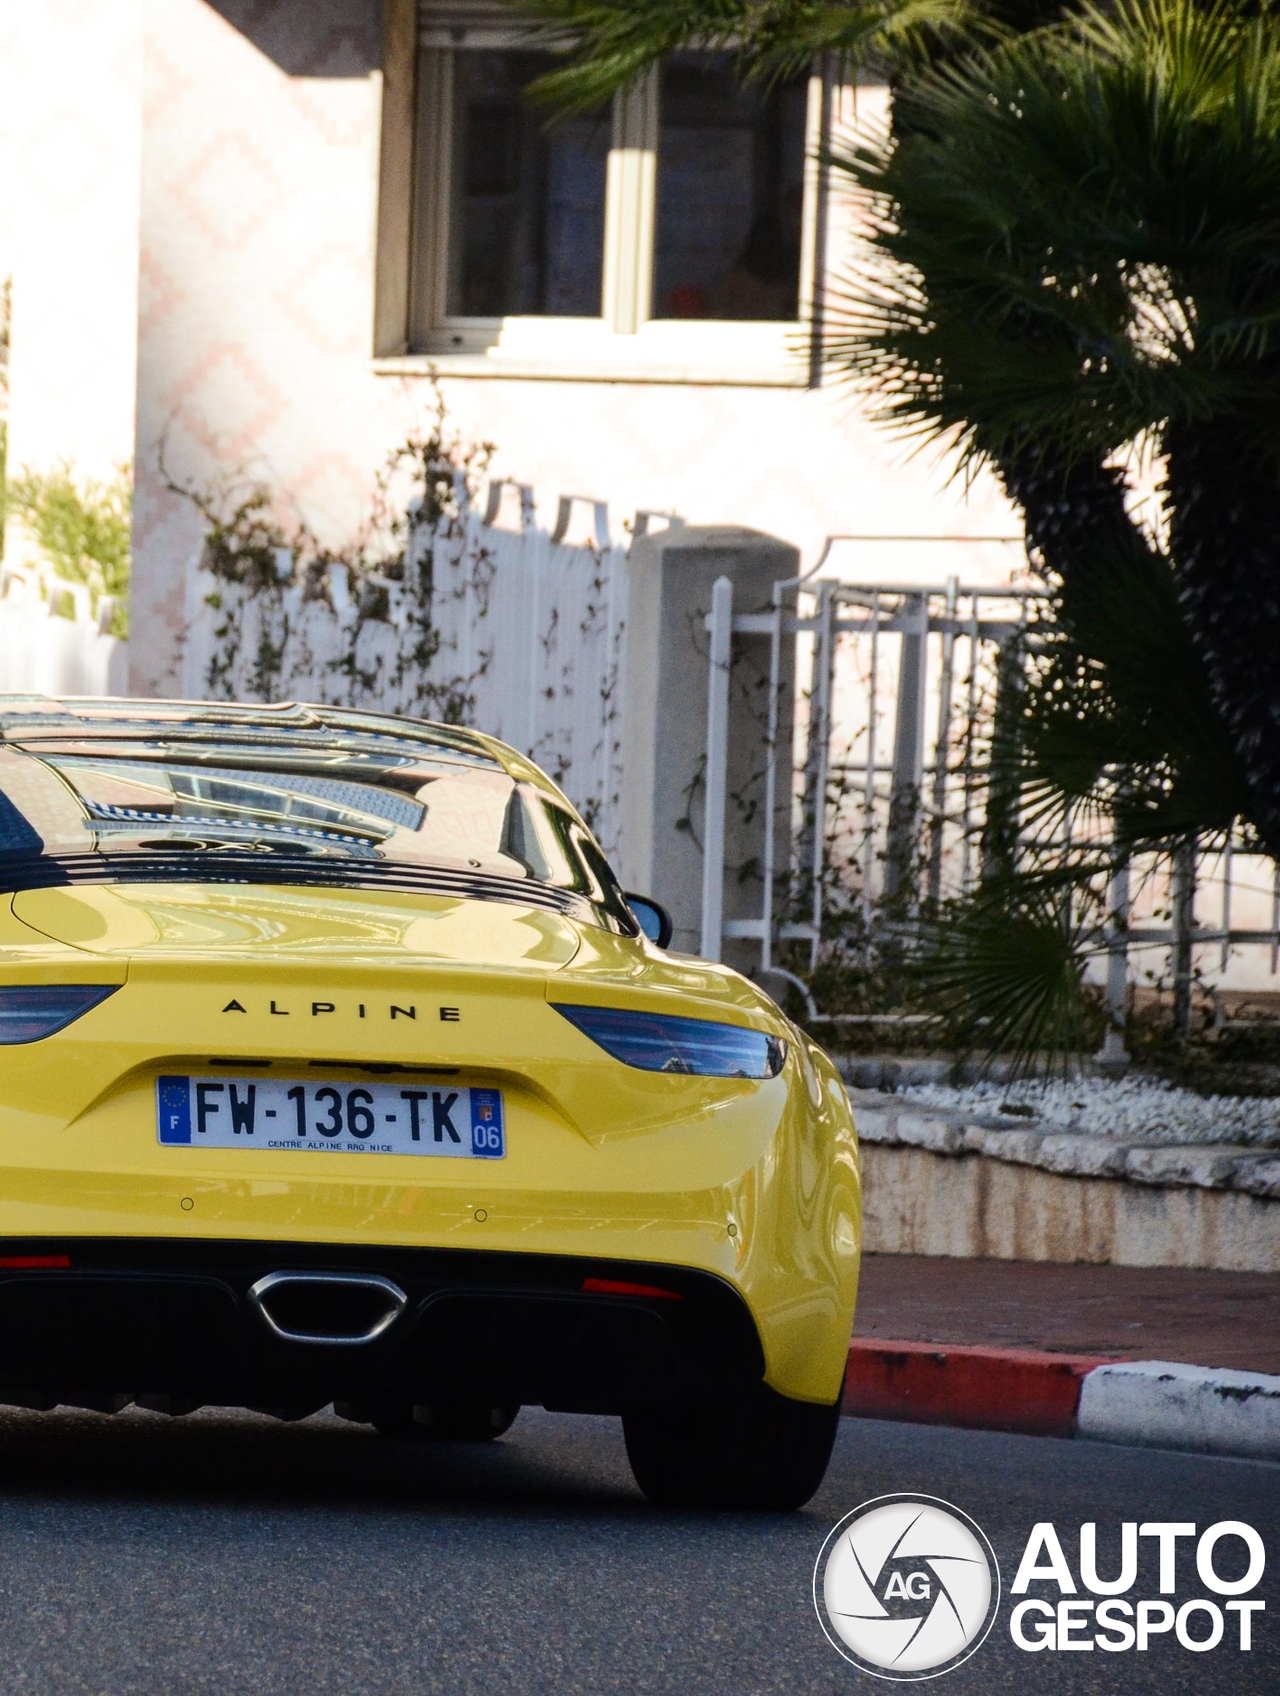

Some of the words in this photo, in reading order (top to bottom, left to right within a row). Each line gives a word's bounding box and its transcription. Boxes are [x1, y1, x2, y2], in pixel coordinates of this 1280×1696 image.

[222, 999, 461, 1022] ALPINE
[170, 1116, 180, 1130] F
[195, 1083, 462, 1143] FW-136-TK
[268, 1140, 302, 1149] CENTRE
[308, 1141, 342, 1150] ALPINE
[370, 1144, 393, 1152] NICE
[474, 1125, 500, 1149] 06
